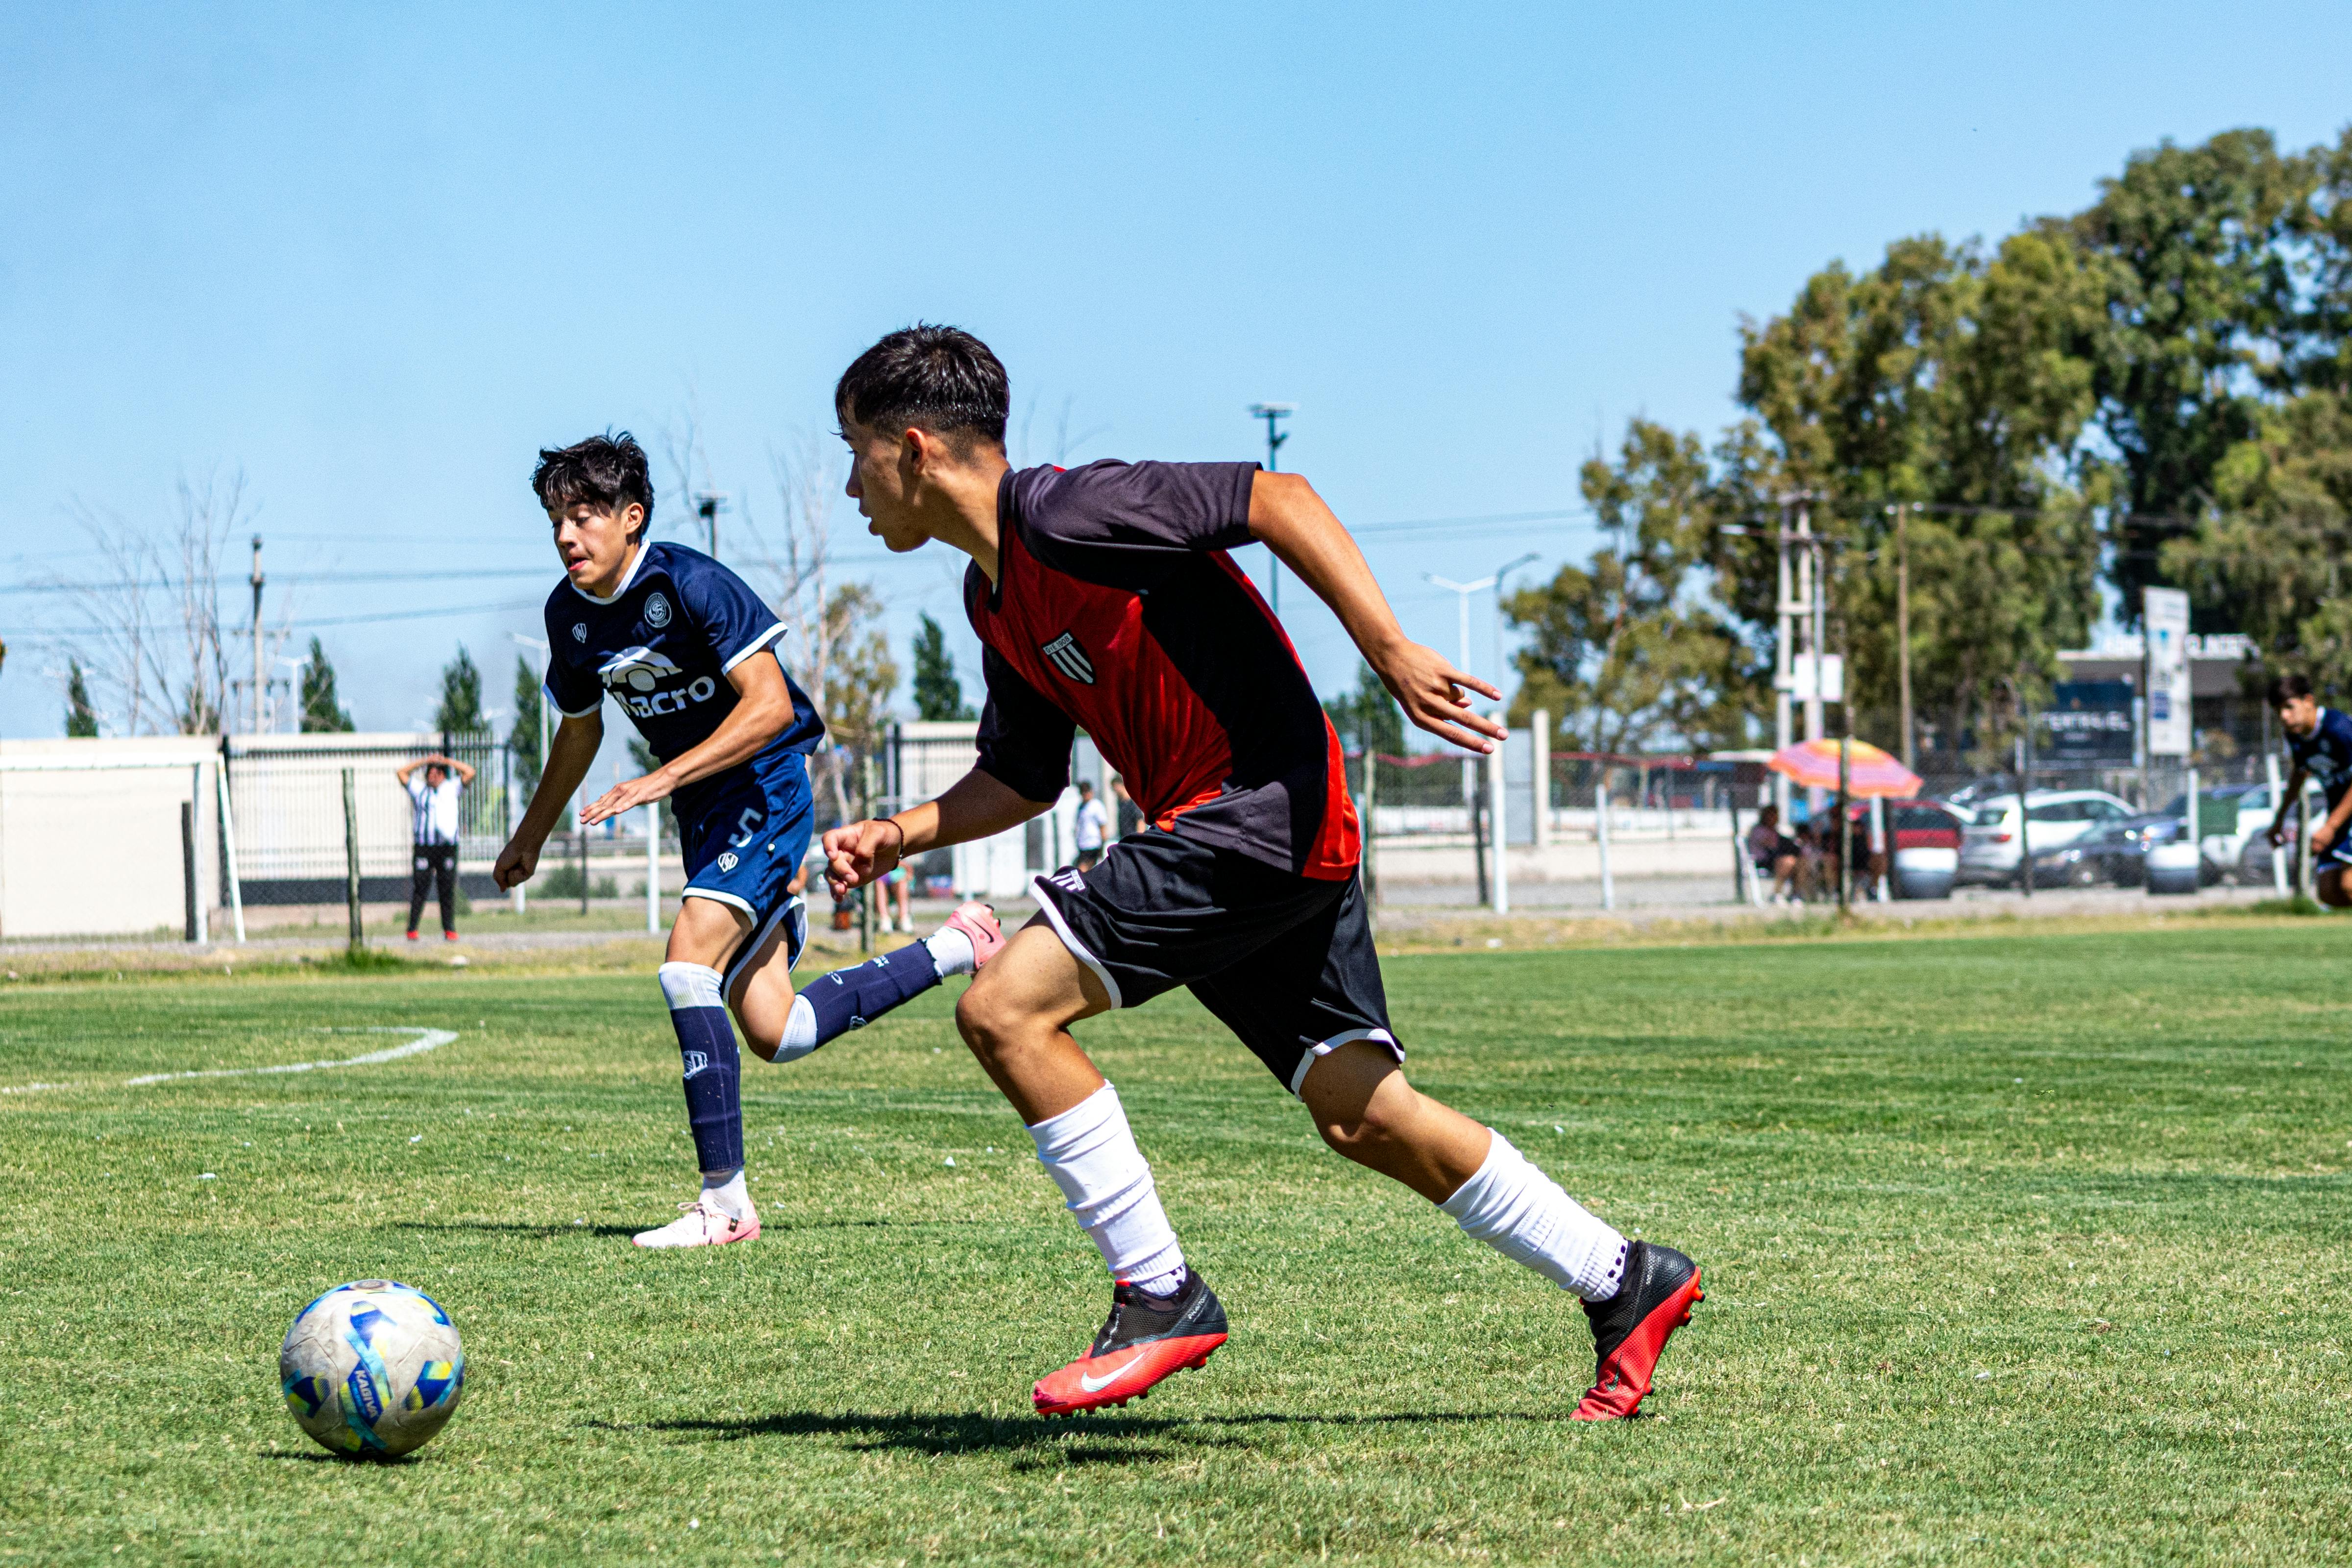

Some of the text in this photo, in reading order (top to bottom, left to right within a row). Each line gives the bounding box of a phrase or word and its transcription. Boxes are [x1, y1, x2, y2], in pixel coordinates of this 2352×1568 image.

[1056, 636, 1070, 647] 1908
[728, 808, 763, 848] 5
[355, 1370, 378, 1418] KAGIVA
